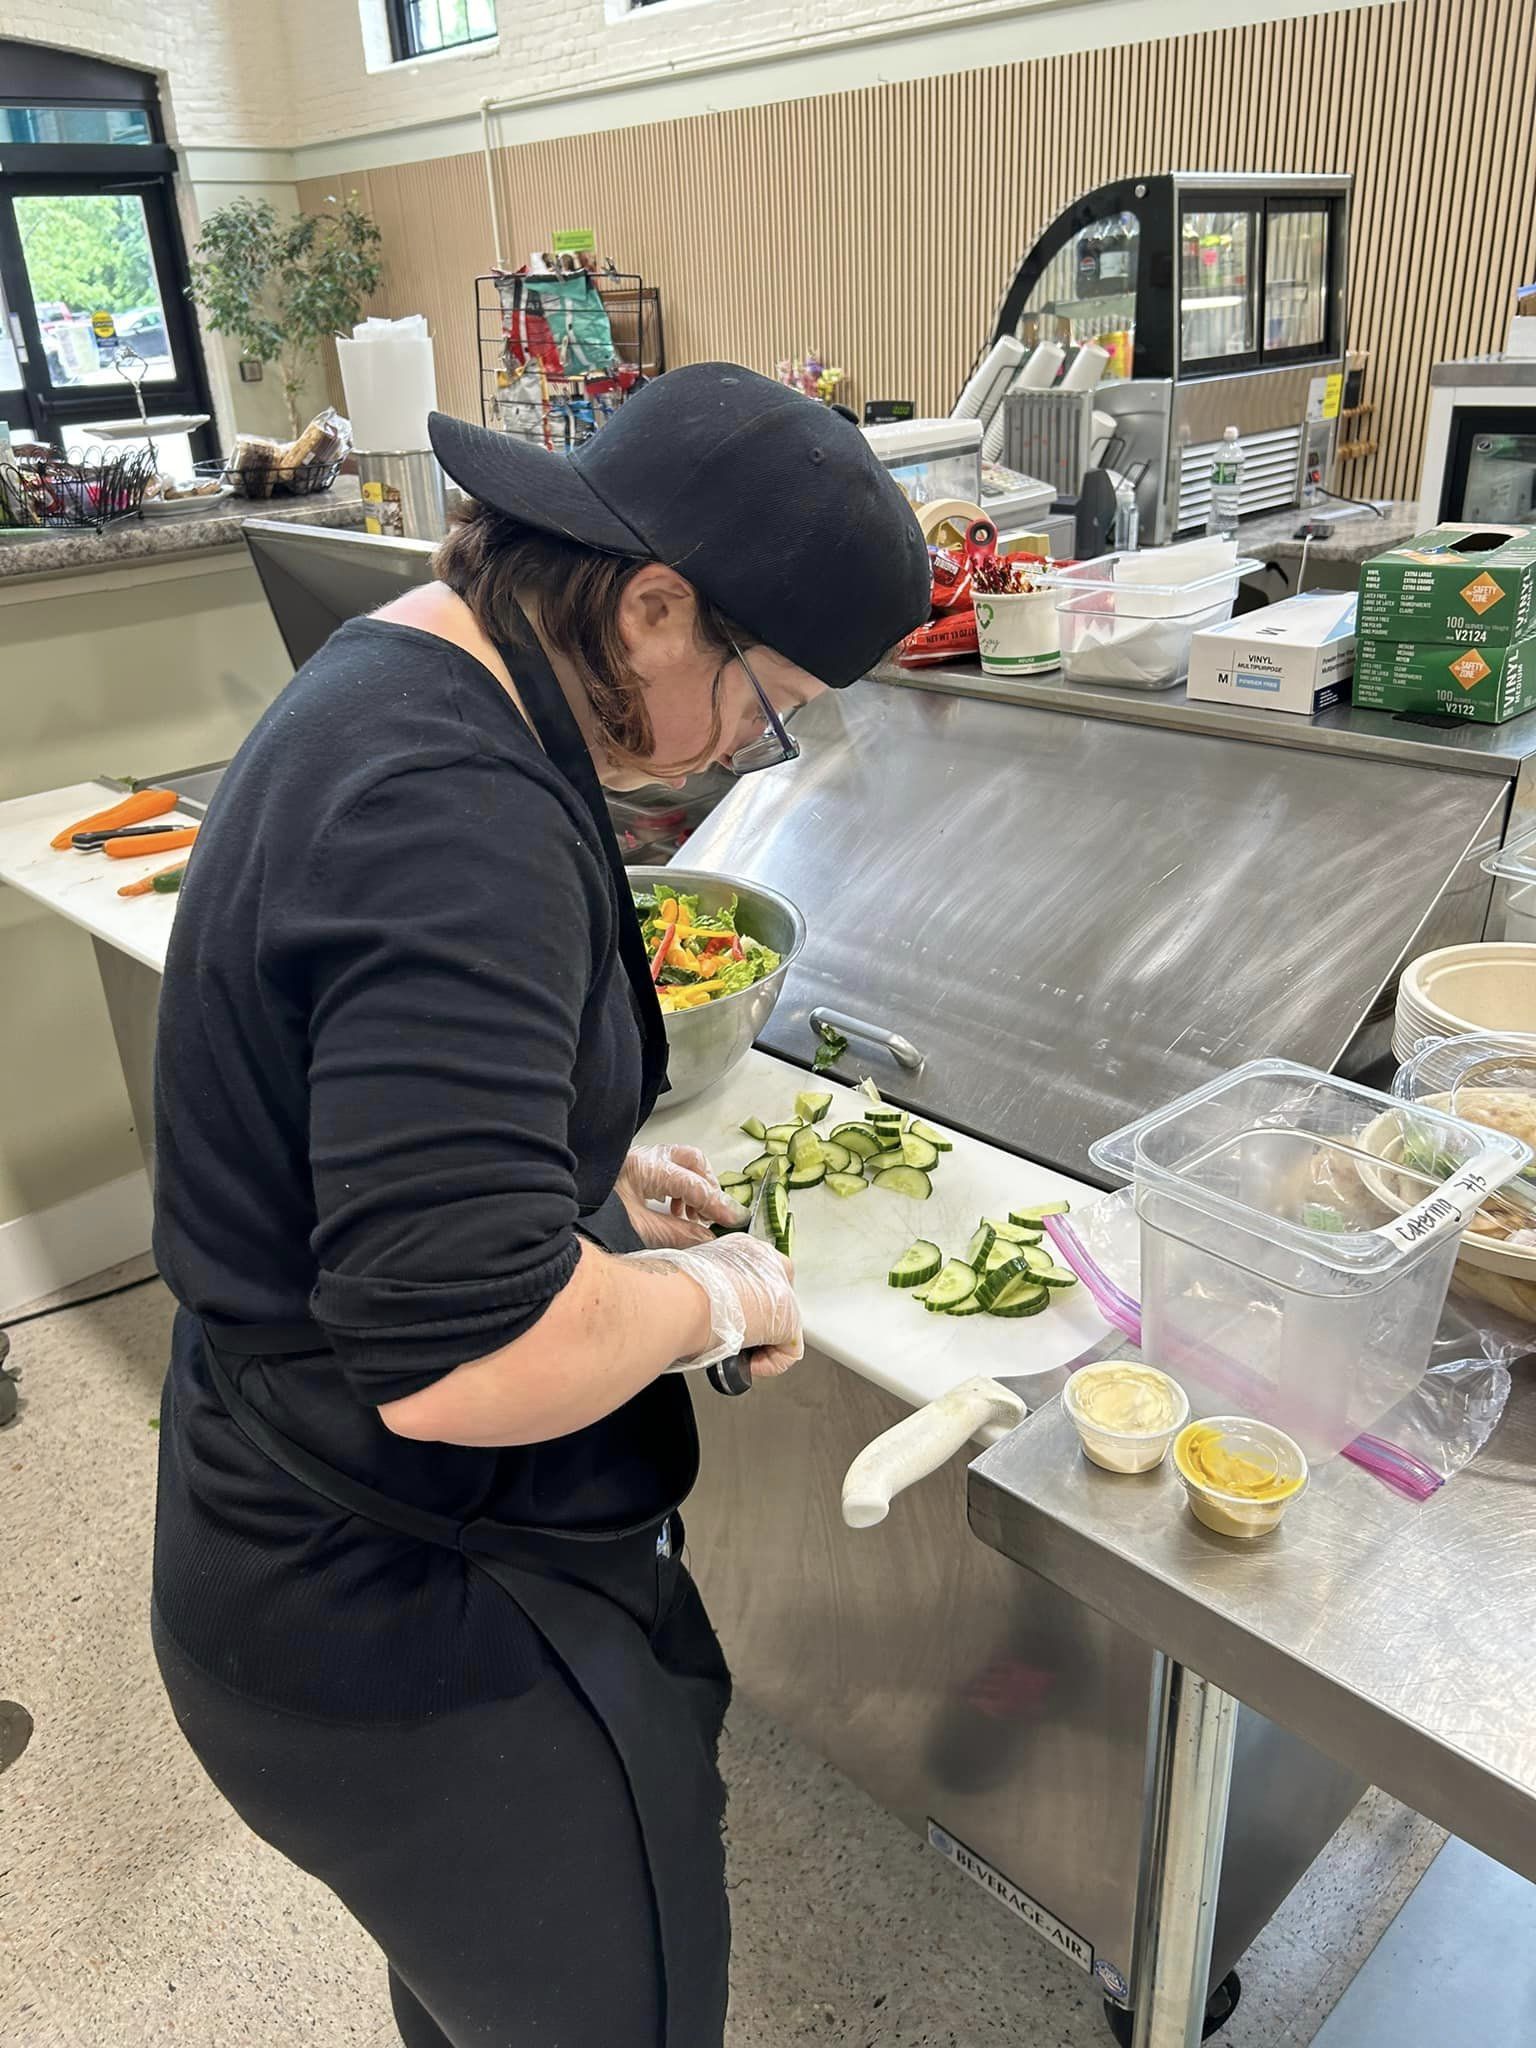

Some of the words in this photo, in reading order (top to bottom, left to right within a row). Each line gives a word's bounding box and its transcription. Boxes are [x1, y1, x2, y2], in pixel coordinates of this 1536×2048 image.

[1472, 585, 1498, 596] SAFETY
[1471, 594, 1488, 603] ZONE
[1446, 616, 1465, 629] 100
[926, 634, 938, 643] NET
[939, 632, 950, 641] WT
[1455, 629, 1487, 643] V2124
[1248, 654, 1273, 665] VINYL
[1237, 662, 1283, 673] MULTIPURPOSE
[1461, 661, 1484, 672] SAFETY
[1217, 672, 1229, 684] M
[1238, 678, 1263, 686] POWDER
[1263, 681, 1278, 689] FREE
[1503, 649, 1520, 709] VINYL
[1514, 663, 1523, 704] MEDIUM
[1436, 689, 1453, 701] 100
[1445, 702, 1475, 716] V2122
[956, 1849, 1084, 1960] BEVERAGE-AIR
